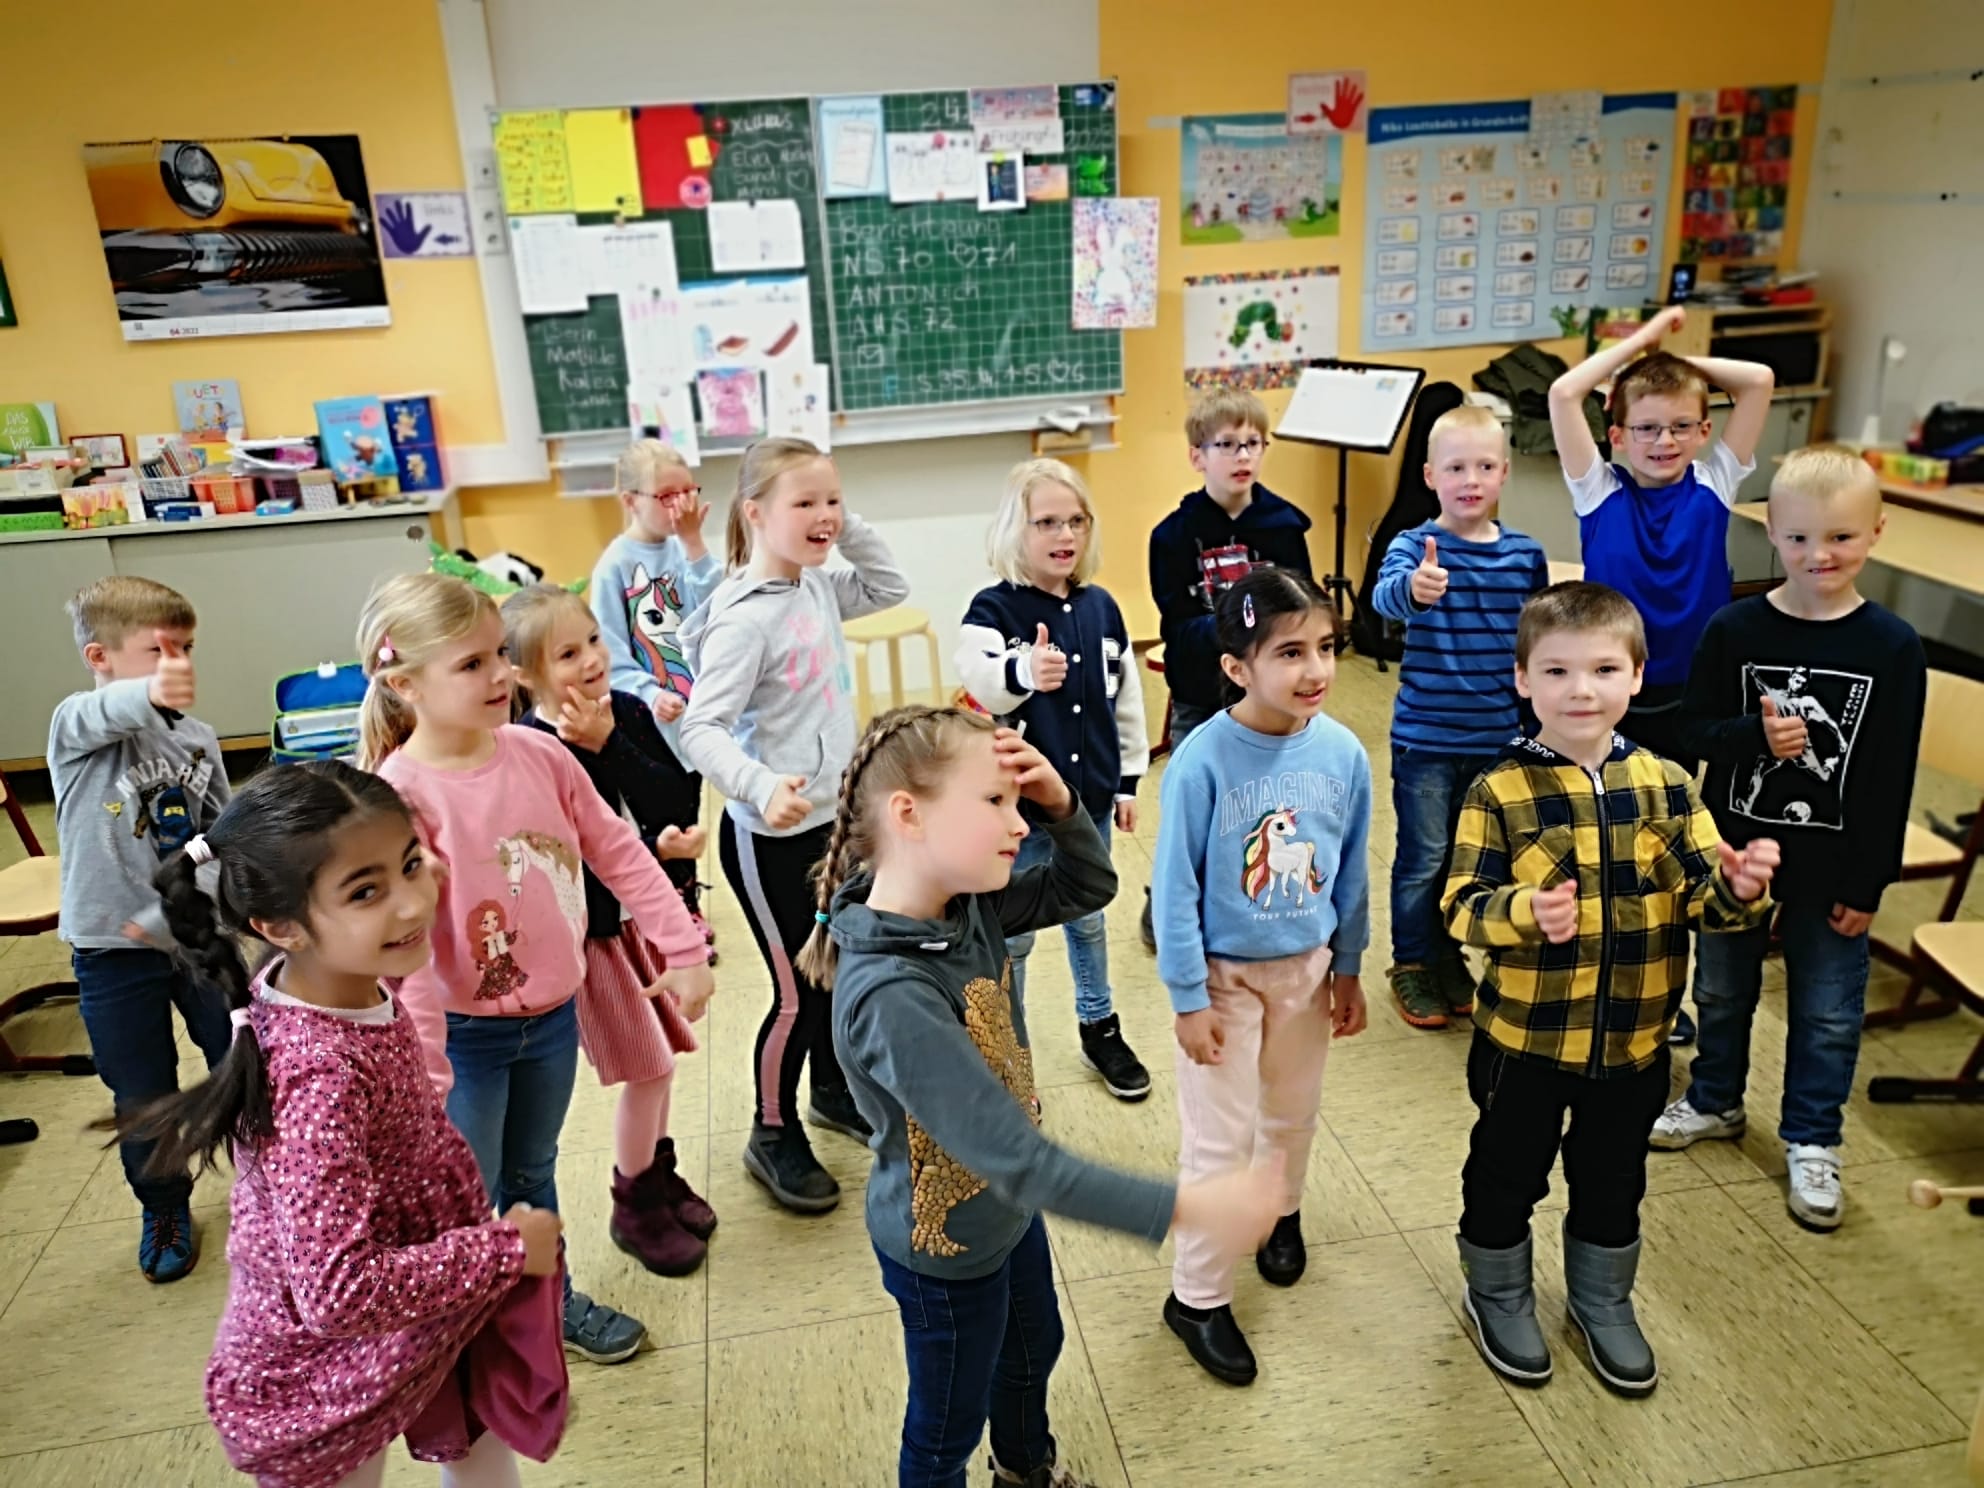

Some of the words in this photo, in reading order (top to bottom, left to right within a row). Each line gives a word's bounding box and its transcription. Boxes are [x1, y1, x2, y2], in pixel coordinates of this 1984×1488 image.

[1220, 771, 1345, 837] IMAGINE
[1253, 912, 1280, 921] YOUR
[1285, 904, 1319, 919] FUTURE
